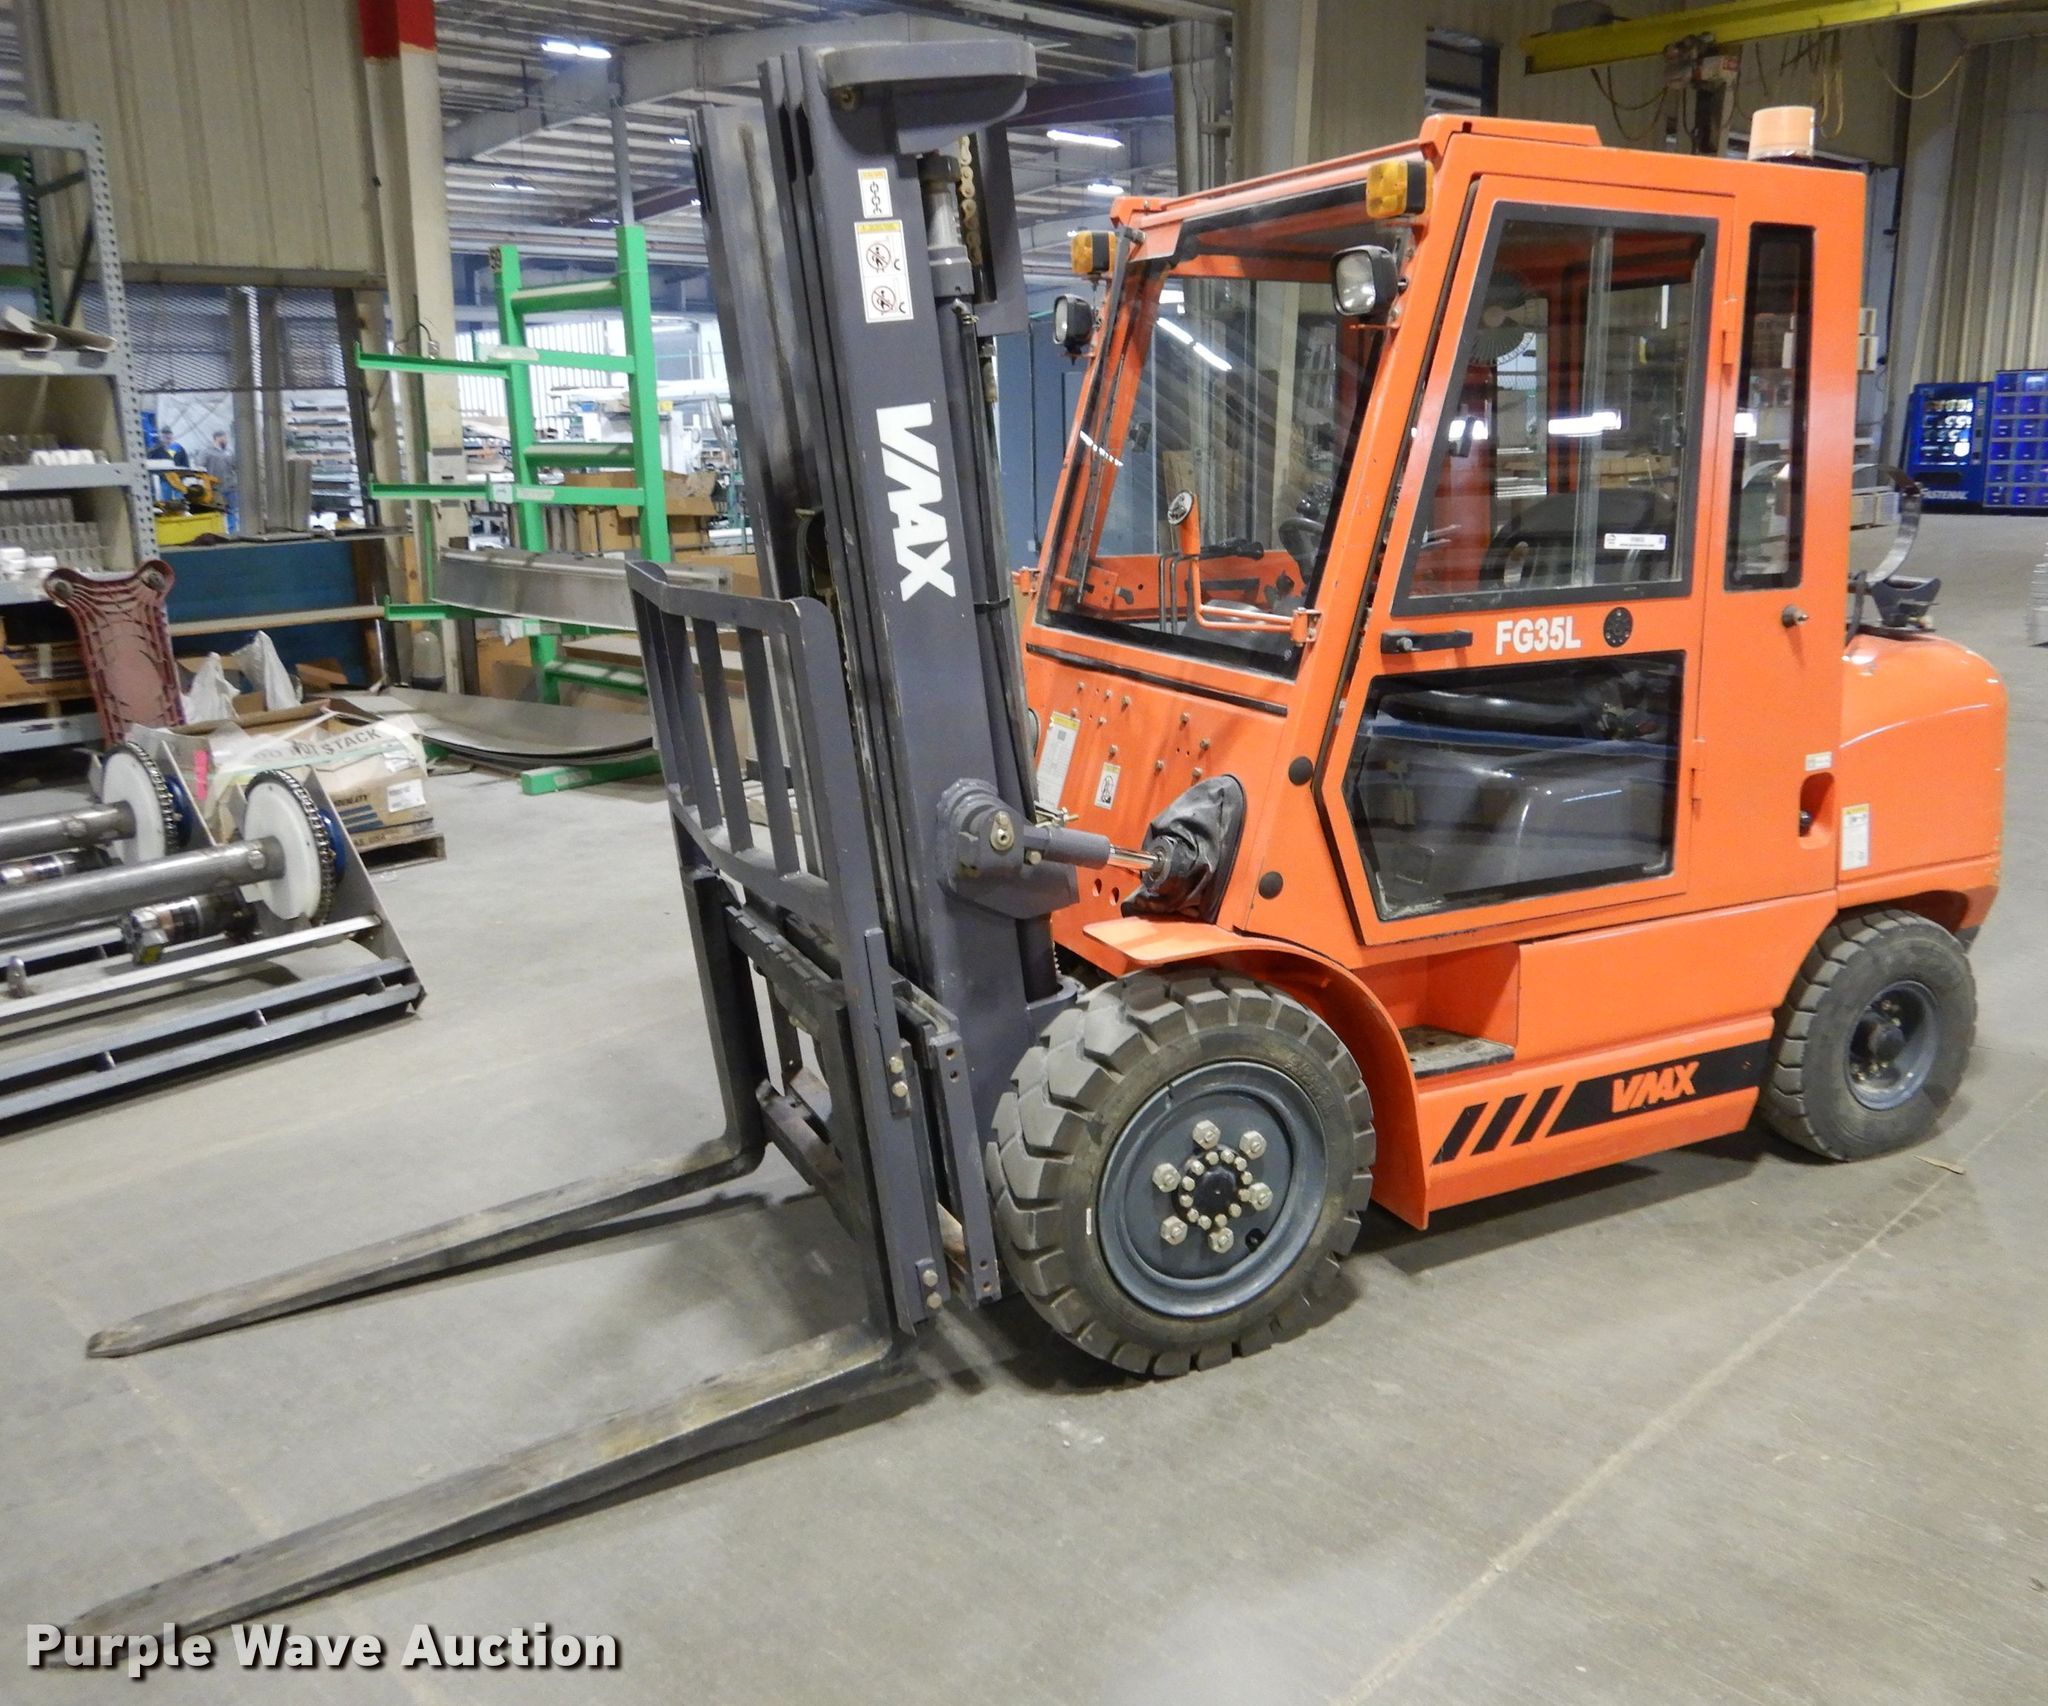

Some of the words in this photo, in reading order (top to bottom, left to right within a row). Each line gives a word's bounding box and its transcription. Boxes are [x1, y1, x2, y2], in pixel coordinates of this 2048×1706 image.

[876, 402, 957, 602] VMAX
[1496, 616, 1581, 656] FG35L
[321, 728, 382, 756] STACK
